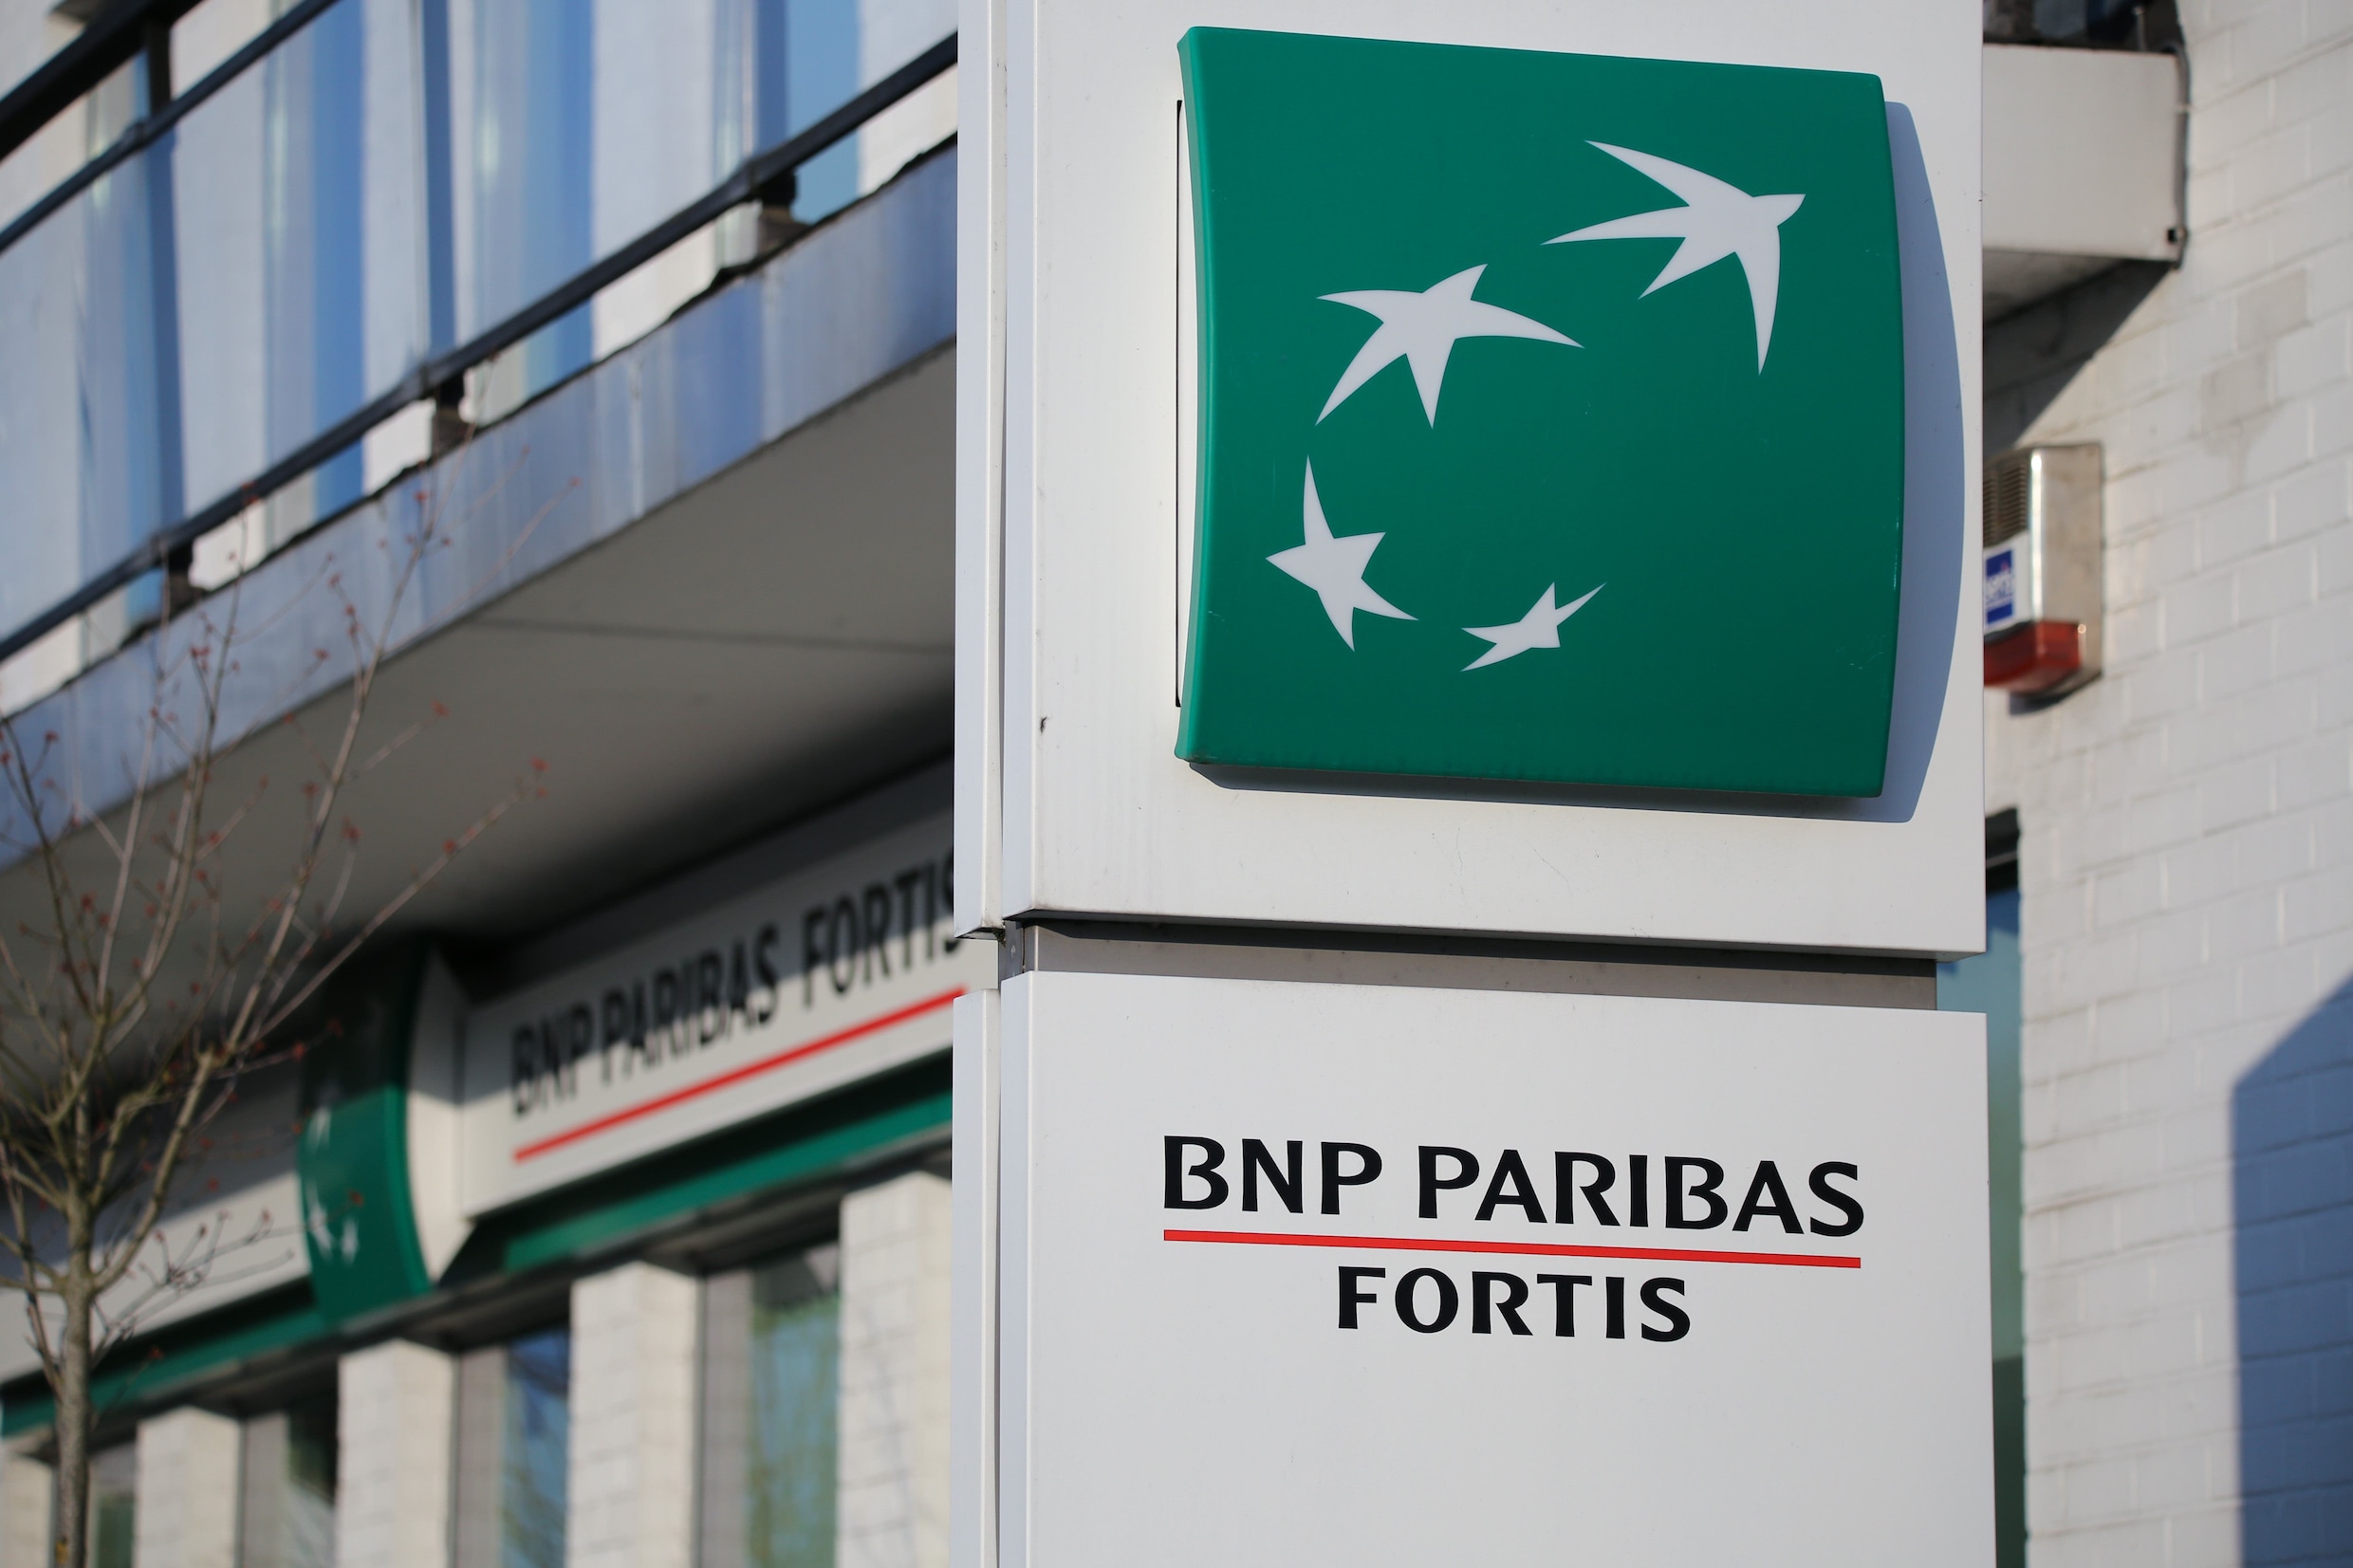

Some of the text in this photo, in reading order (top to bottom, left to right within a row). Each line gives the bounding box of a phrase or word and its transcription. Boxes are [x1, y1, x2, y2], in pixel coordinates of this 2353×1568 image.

[512, 999, 595, 1115] BNP
[600, 922, 780, 1085] PARIBAS
[1163, 1135, 1864, 1238] BNP PARIBAS
[1338, 1265, 1691, 1342] FORTIS
